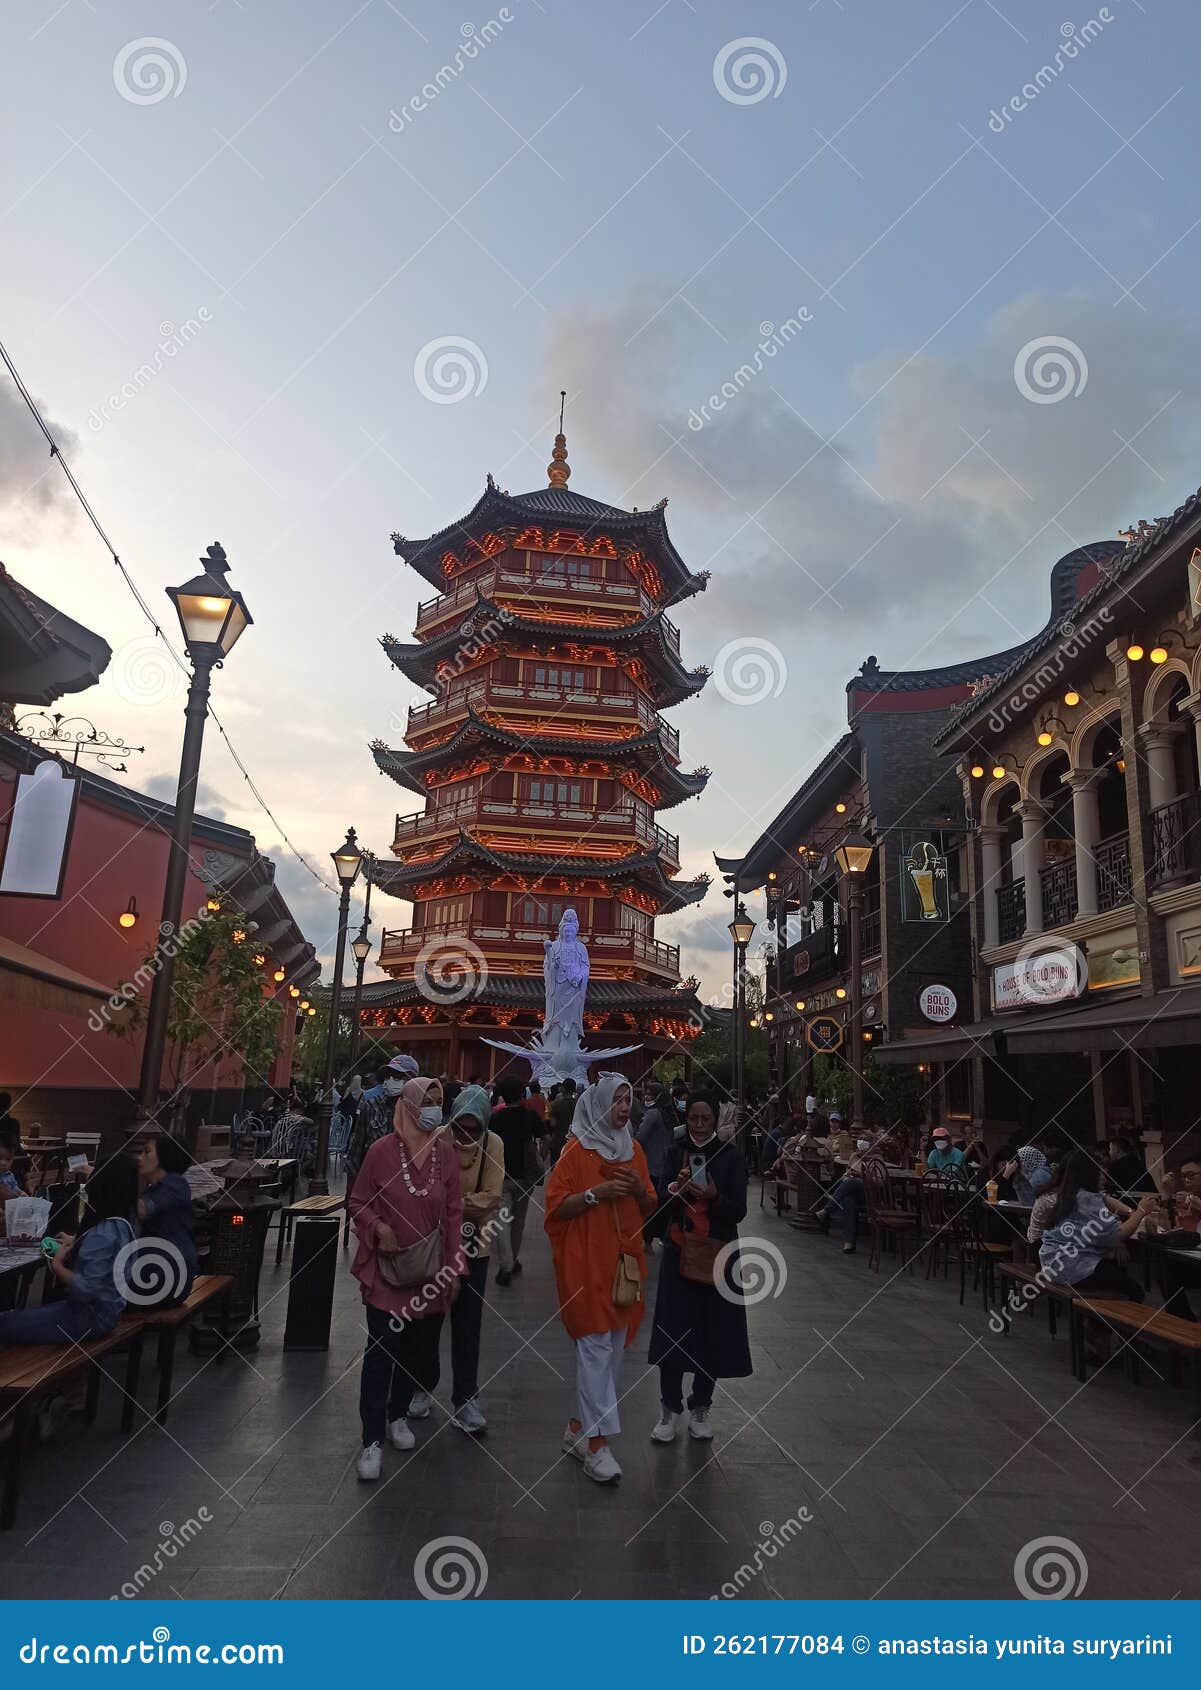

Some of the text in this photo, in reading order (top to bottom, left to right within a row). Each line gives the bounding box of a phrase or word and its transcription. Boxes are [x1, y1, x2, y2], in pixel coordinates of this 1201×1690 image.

[1003, 965, 1068, 992] HOUSE OF BOLO BUNS
[927, 994, 950, 1006] BOLO
[927, 1005, 950, 1016] BUNS
